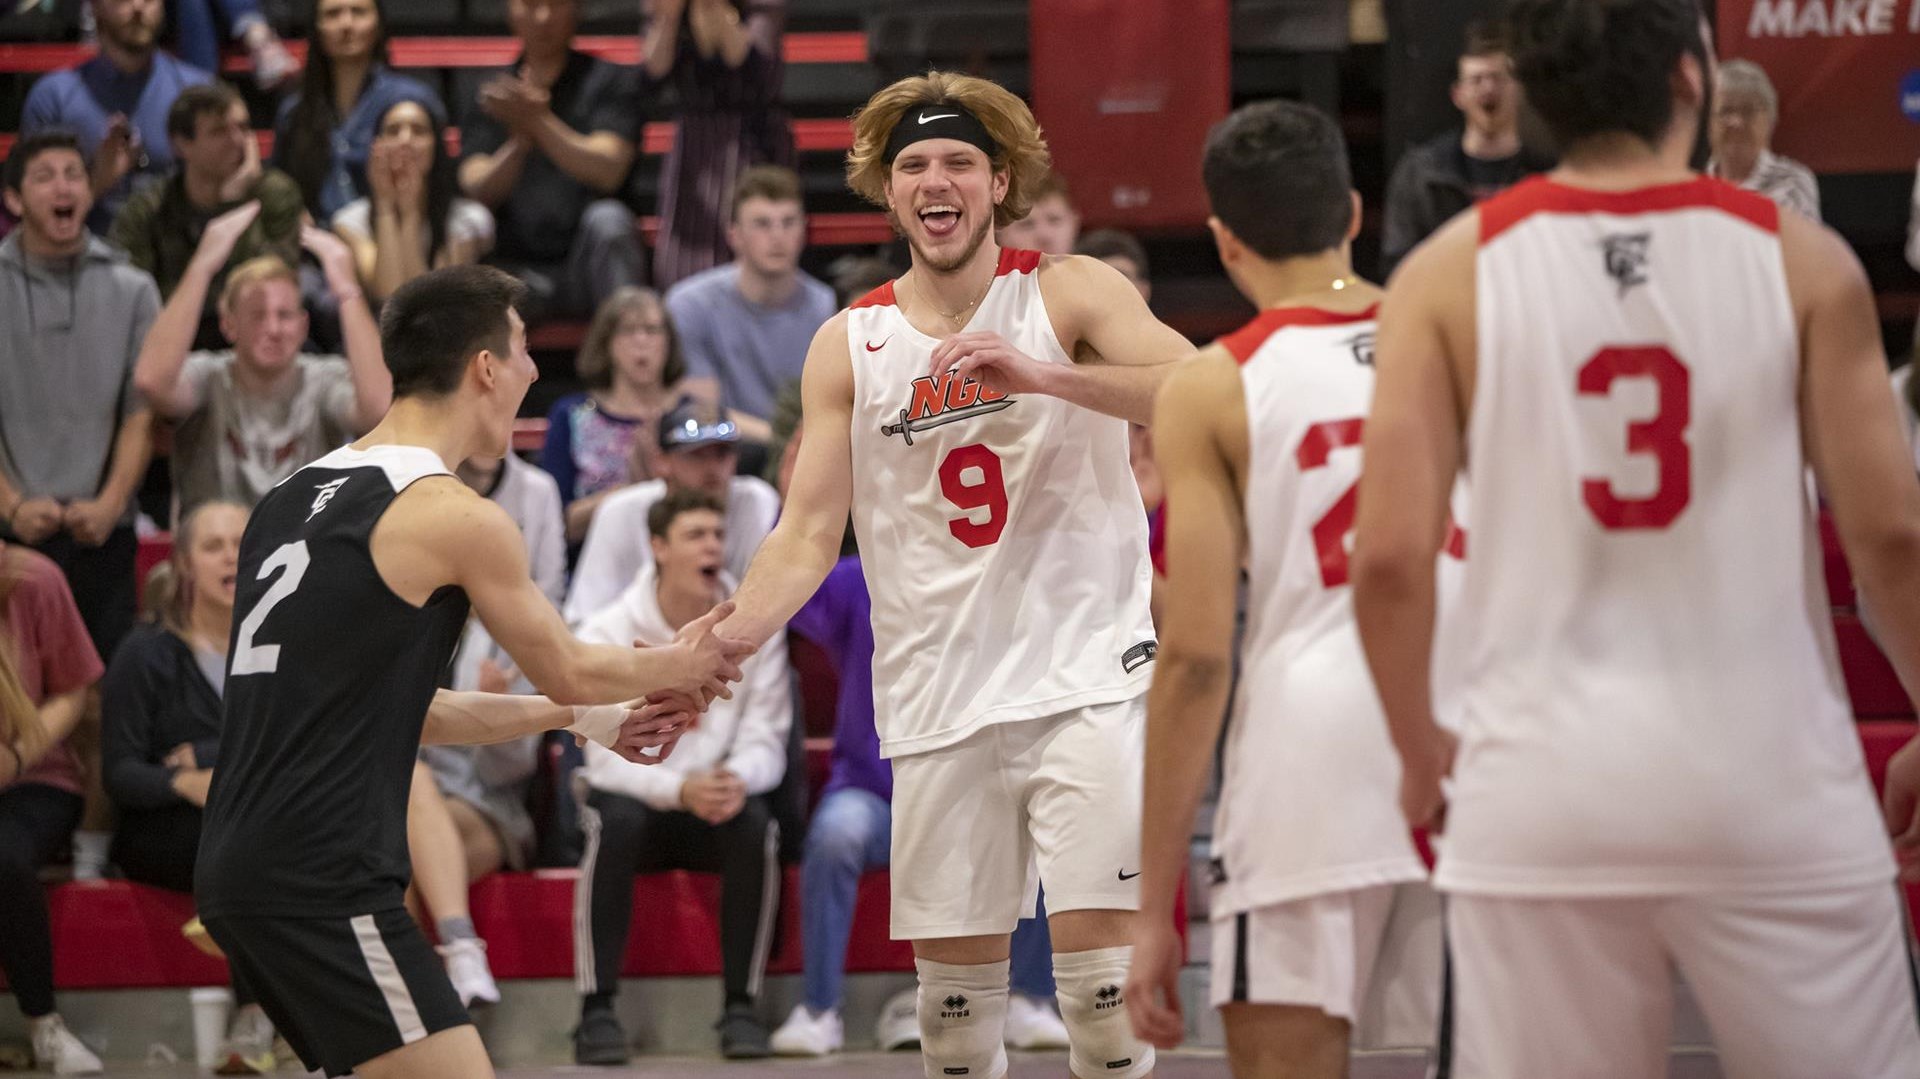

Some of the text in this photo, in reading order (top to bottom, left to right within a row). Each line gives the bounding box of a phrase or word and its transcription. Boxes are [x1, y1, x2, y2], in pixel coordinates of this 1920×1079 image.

[1748, 0, 1897, 38] MAKE
[938, 443, 1009, 548] 9
[1577, 344, 1690, 531] 3
[230, 539, 311, 676] 2
